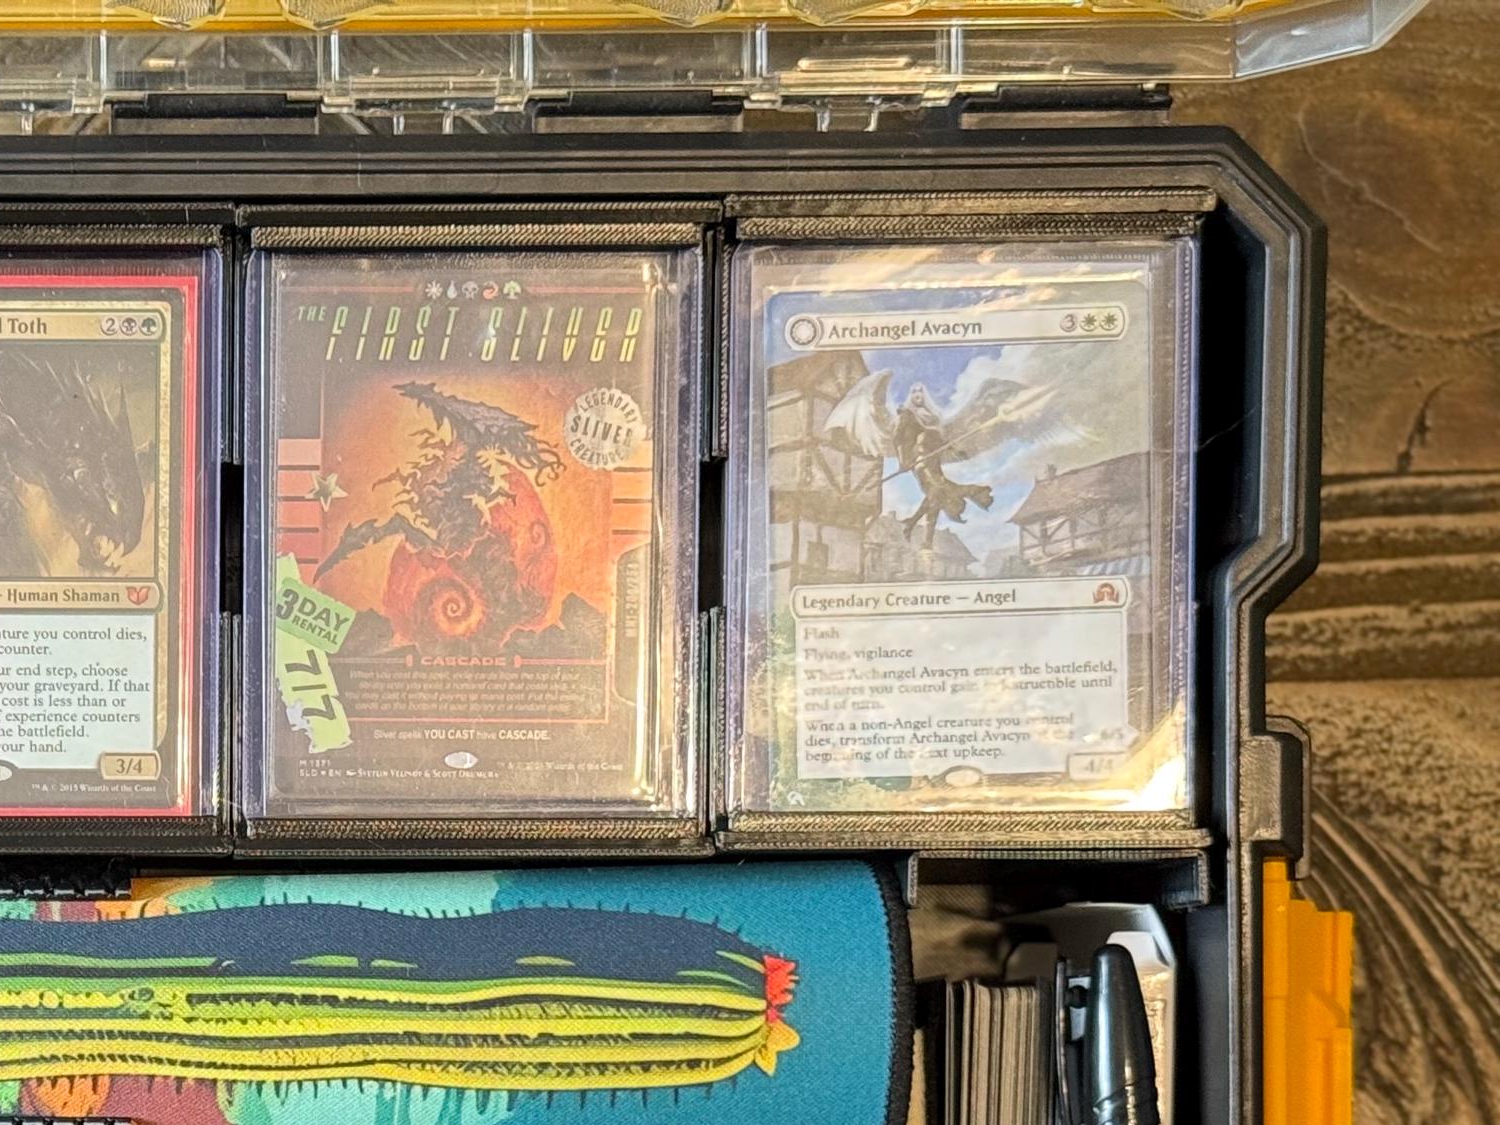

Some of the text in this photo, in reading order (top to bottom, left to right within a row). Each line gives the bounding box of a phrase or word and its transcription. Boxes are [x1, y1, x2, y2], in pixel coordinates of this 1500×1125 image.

[7, 317, 46, 334] Toth
[297, 306, 644, 362] THE FIRST SLIVER
[829, 317, 982, 342] Archangel Avacyn
[580, 391, 639, 423] LEGENDARY
[570, 415, 634, 447] SLIVER
[7, 588, 57, 601] Human
[62, 588, 119, 601] Shaman
[803, 590, 1015, 610] Legendary Creature Angel
[276, 588, 350, 632] 3 DAY
[33, 630, 57, 643] you
[63, 627, 110, 640] control
[116, 627, 146, 641] dies,
[292, 615, 338, 645] RENTAL
[421, 656, 507, 666] CASCADE
[854, 647, 913, 661] vigilance
[16, 662, 40, 675] end
[46, 664, 77, 679] step,
[81, 662, 127, 675] choose
[920, 667, 969, 679] Avacyn
[1019, 663, 1042, 675] the
[1045, 661, 1117, 676] battlefield,
[424, 730, 446, 740] YOU
[448, 730, 474, 740] CAST
[499, 730, 551, 740] CASCADE.
[29, 739, 66, 752] hand.
[116, 758, 143, 774] 3/4
